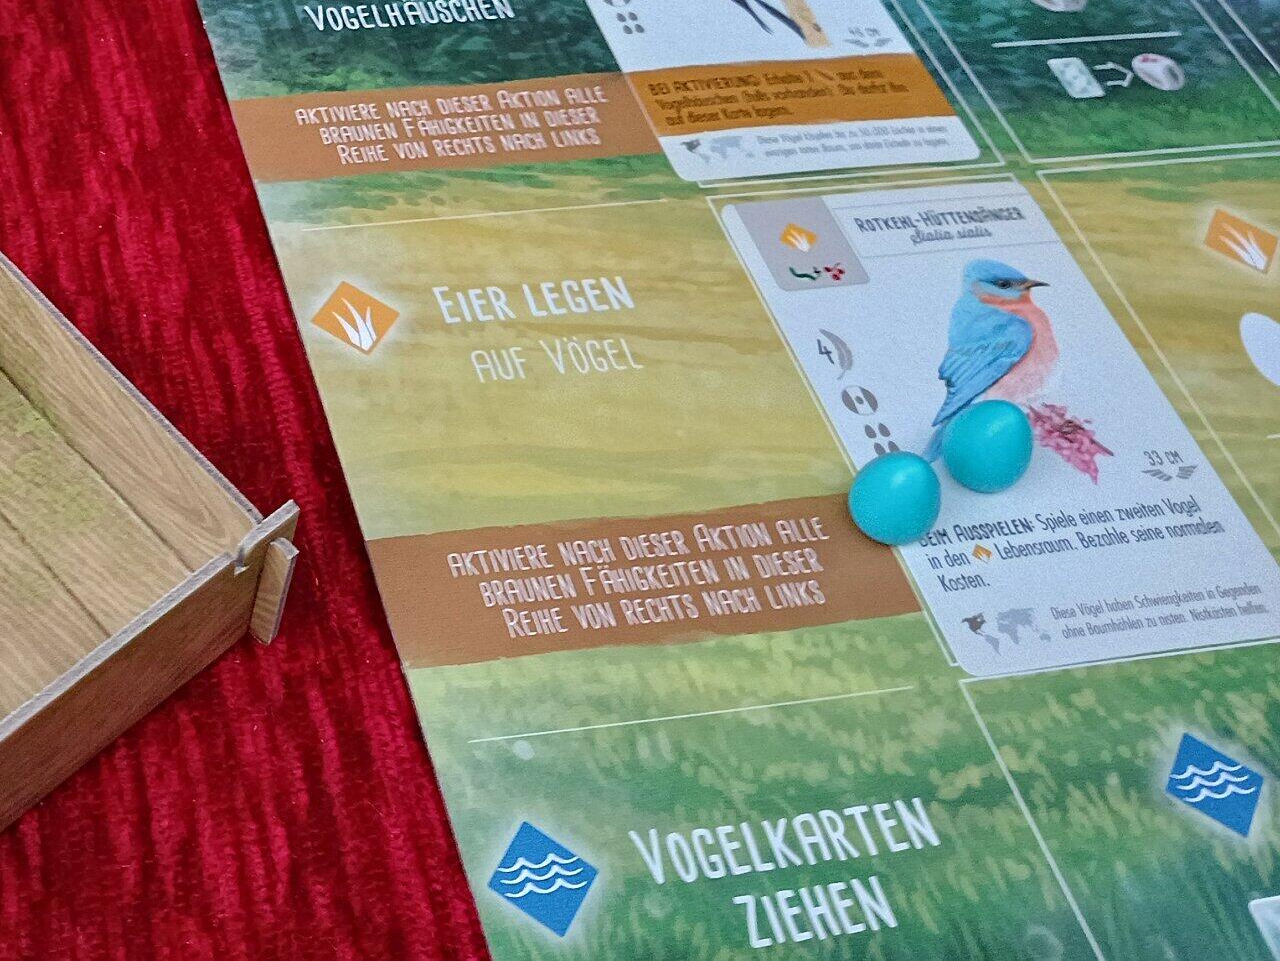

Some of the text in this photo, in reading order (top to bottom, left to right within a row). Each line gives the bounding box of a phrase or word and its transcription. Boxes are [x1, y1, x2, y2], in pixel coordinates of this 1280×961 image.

[295, 85, 609, 126] AKTIVIERE NACH DIESER AKTION ALLE
[319, 107, 601, 146] BRAUNEN FÄHIGKEITEN IN DIESER
[336, 127, 602, 166] REIHE VON RECHTS NACH LINKS
[431, 276, 636, 326] EIER LEGEN
[470, 334, 644, 384] AUF VÖGEL
[816, 338, 835, 365] 4
[1143, 450, 1164, 467] 33
[954, 518, 1037, 544] AUSSPIELEN:
[1039, 509, 1078, 531] Spiele
[1078, 508, 1113, 526] einen
[1117, 501, 1165, 521] zweiten
[1165, 494, 1203, 518] Vogel
[446, 515, 831, 579] AKTIVIERE NACH DIESER AKTION ALLE
[925, 554, 941, 571] in
[948, 548, 971, 568] den
[993, 538, 1077, 562] Lebensraum.
[1078, 526, 1129, 550] Bezahle
[1132, 525, 1165, 542] seine
[478, 547, 825, 608] BRAUNEN FÄHIGKEITEN IN DIESER
[938, 572, 991, 593] Kosten.
[501, 579, 827, 639] REIHE VON RECHTS NACH LINKS
[627, 796, 941, 885] VOGELKARTEN
[731, 874, 900, 949] ZIEHEN
